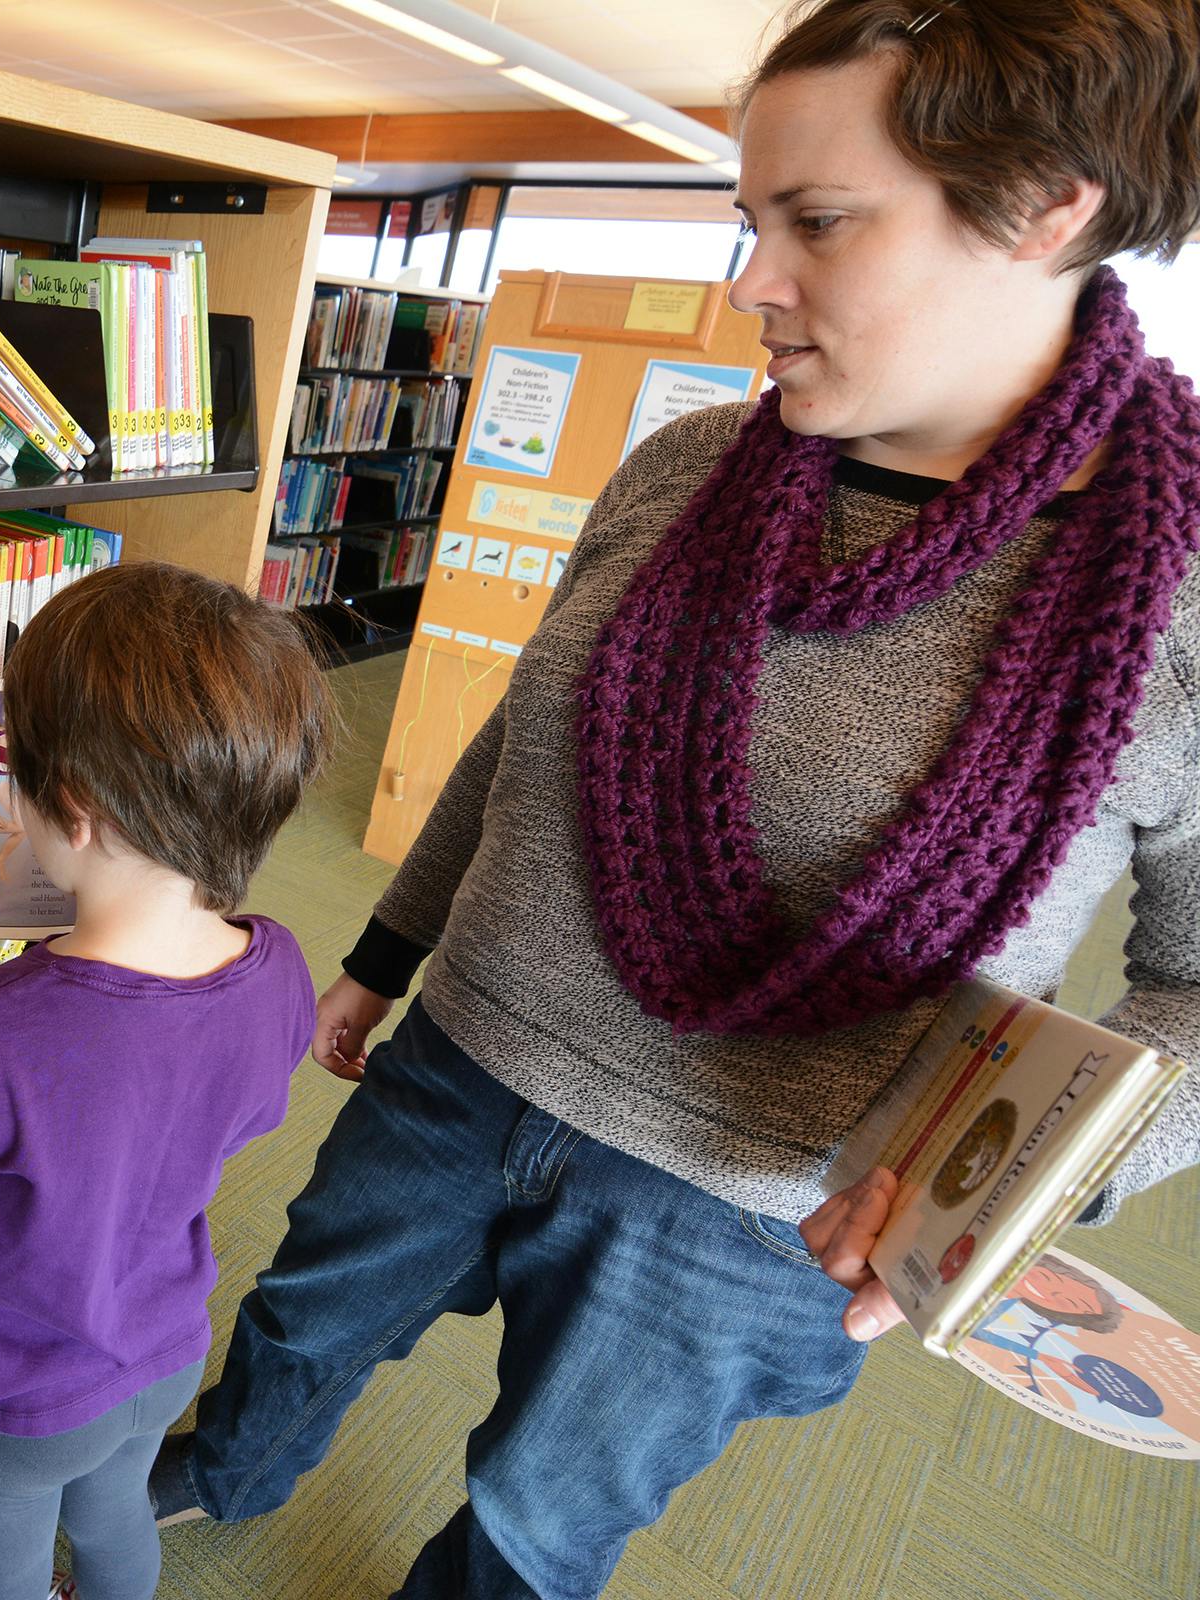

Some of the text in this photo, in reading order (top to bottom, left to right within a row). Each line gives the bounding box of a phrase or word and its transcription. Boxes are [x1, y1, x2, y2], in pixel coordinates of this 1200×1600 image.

[32, 274, 51, 291] Nate
[37, 295, 48, 304] and
[512, 368, 548, 379] Children's
[506, 379, 548, 390] Non-Fiction
[673, 383, 715, 395] Children's
[550, 497, 577, 516] Say
[538, 517, 578, 535] words
[970, 1360, 985, 1372] TO
[988, 1373, 1028, 1399] KNOW
[1031, 1398, 1064, 1417] HOW
[1068, 1415, 1087, 1428] TO
[1089, 1423, 1126, 1442] RAISE
[1142, 1437, 1187, 1450] READER
